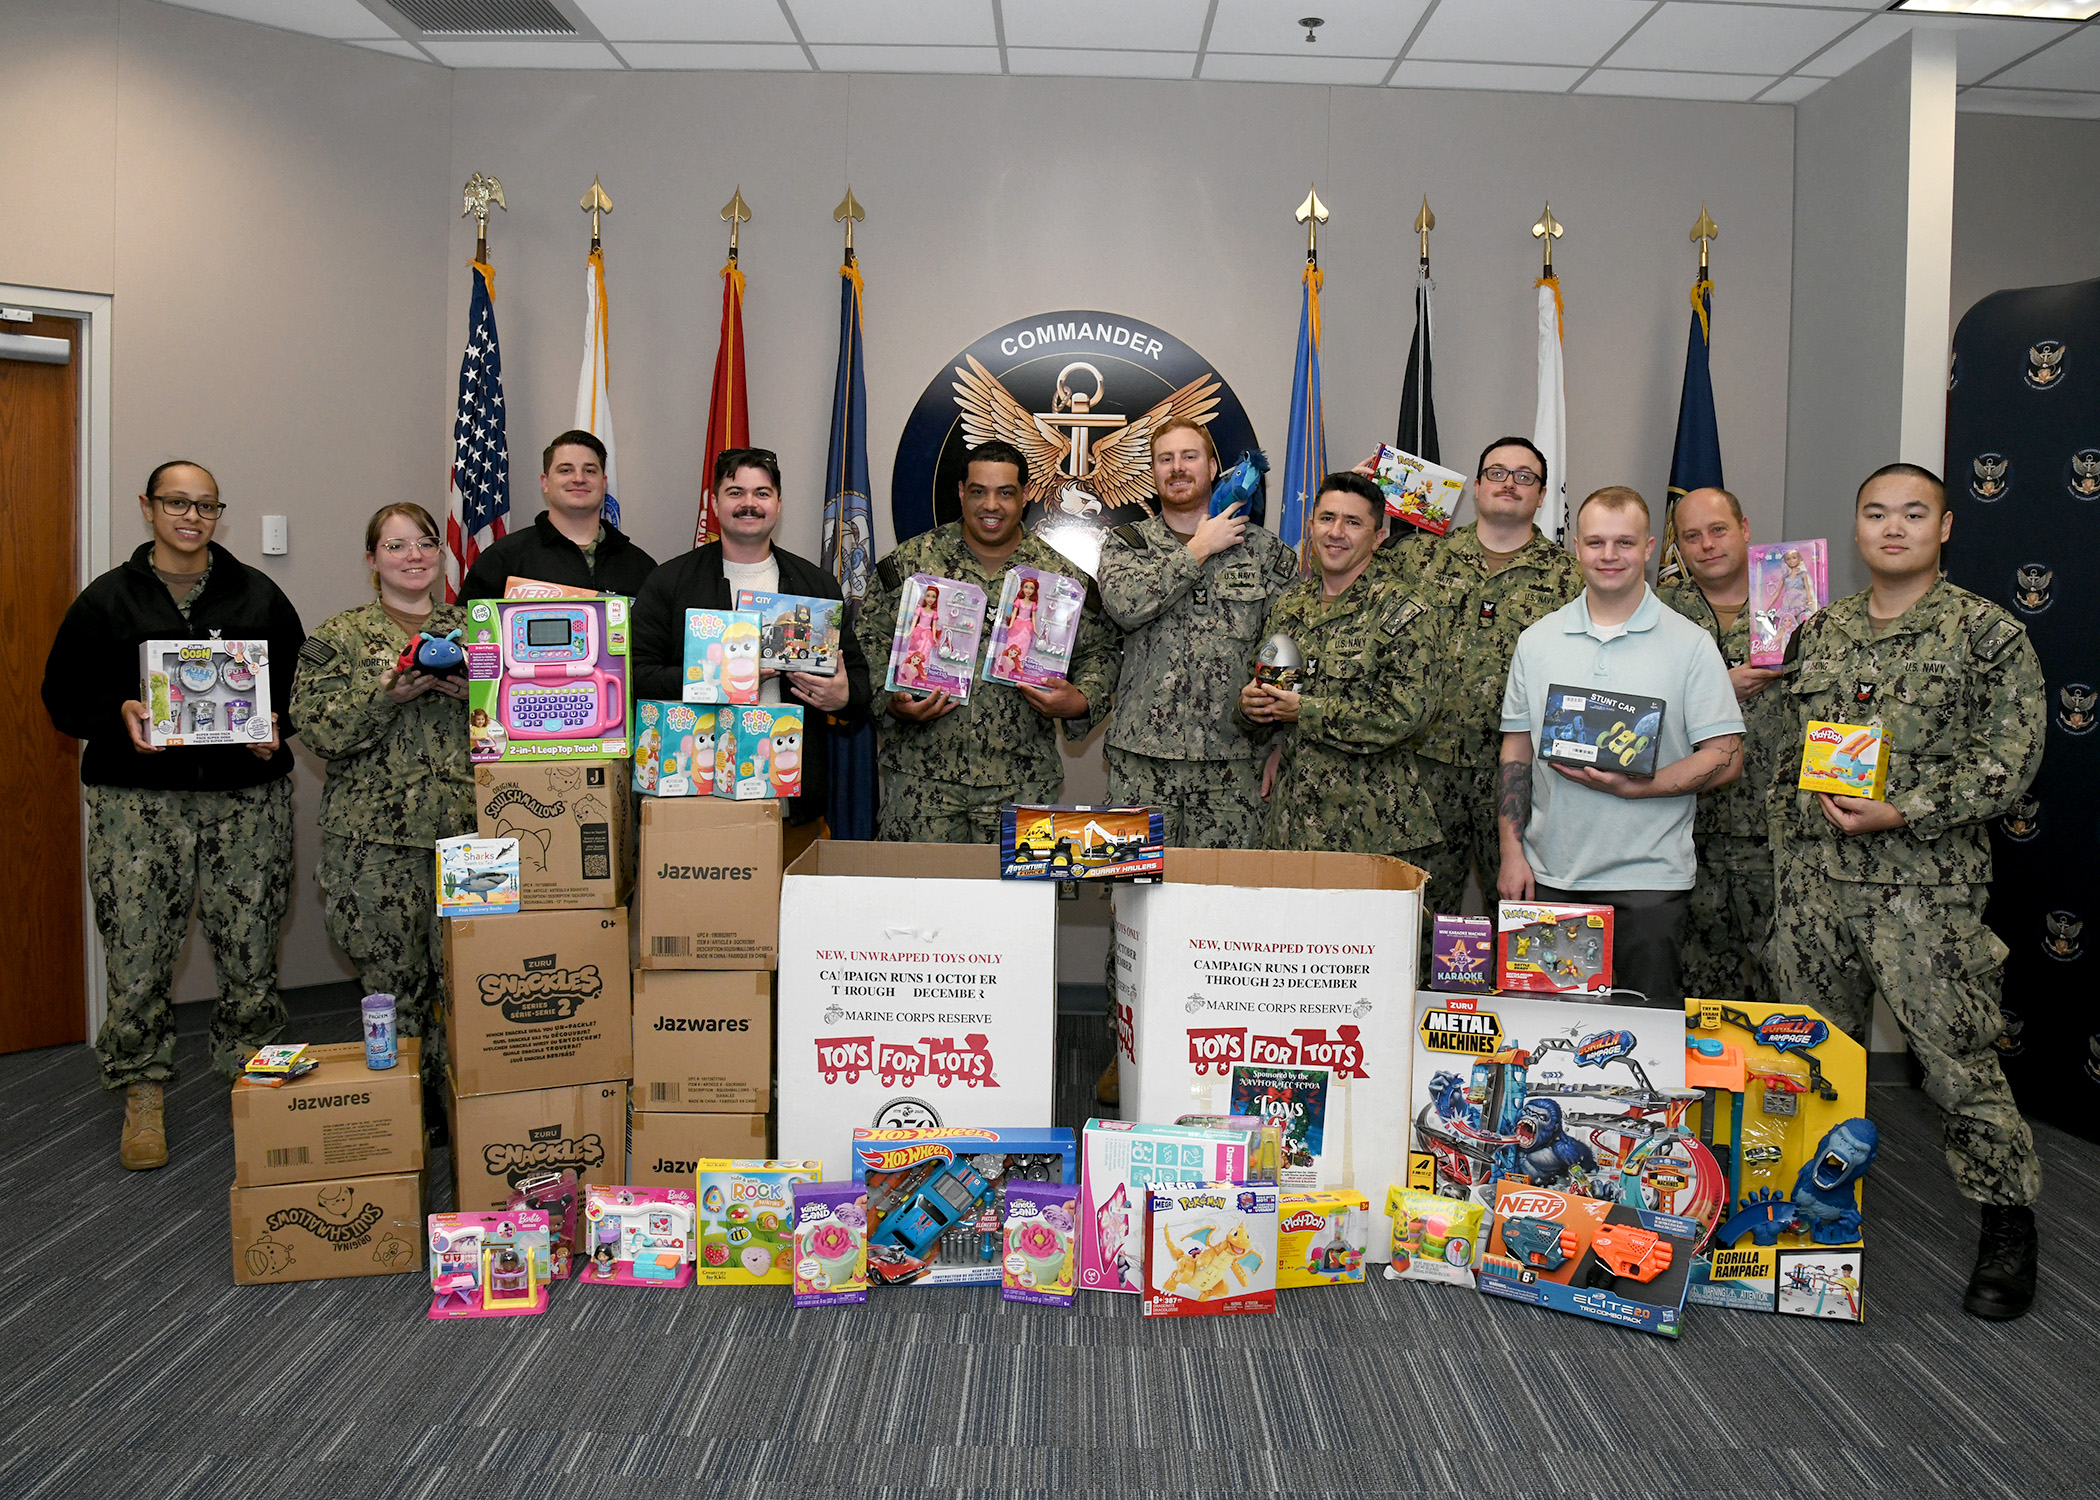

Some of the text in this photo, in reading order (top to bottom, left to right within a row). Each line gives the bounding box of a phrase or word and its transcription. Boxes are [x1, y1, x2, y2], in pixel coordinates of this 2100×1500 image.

[1000, 322, 1164, 361] COMMANDER
[1239, 571, 1256, 580] NAVY
[755, 595, 772, 605] CITY
[690, 614, 723, 628] Potato
[690, 623, 725, 639] Head
[1750, 640, 1779, 654] Barbie
[1905, 663, 1946, 674] U.S. NAVY
[1591, 693, 1636, 714] STUNT CAR
[668, 706, 696, 719] Potato
[743, 709, 773, 722] Potato
[667, 714, 697, 732] Head
[743, 718, 775, 735] Head
[510, 742, 598, 756] 2-in-1 LeapTop Touch
[492, 782, 520, 794] ORIGINAL
[485, 789, 565, 819] SQUISHMALLOWS
[464, 851, 495, 861] Sharks
[658, 863, 752, 880] Jazwares
[1006, 862, 1048, 874] ADVENTURE
[1090, 867, 1120, 876] QUARRY
[1122, 862, 1157, 873] HAULERS
[601, 920, 616, 929] 0+
[1189, 939, 1376, 955] NEW, UNWRAPPED TOYS ONLY
[816, 949, 1003, 964] NEW, UNWRAPPED TOYS ONLY
[528, 960, 552, 968] ZURU
[1193, 959, 1370, 975] CAMPAIGN RUNS 1 OCTOBER
[890, 972, 924, 984] RUNS
[927, 974, 932, 984] 1
[1205, 975, 1358, 989] THROUGH 23 DECEMBER
[1437, 972, 1484, 980] KARAOKE
[478, 965, 603, 1006] SNACKLES
[522, 1002, 548, 1010] SERIES
[557, 998, 571, 1016] 2
[1206, 1001, 1352, 1014] MARINE CORPS RESERVE
[1450, 1002, 1474, 1011] ZURU
[653, 1016, 749, 1032] Jazwares
[845, 1010, 992, 1024] MARINE CORPS RESERVE
[1429, 1012, 1494, 1035] METAL
[1761, 1021, 1815, 1034] GORILLA
[1428, 1031, 1495, 1054] MACHINES
[1768, 1034, 1812, 1044] RAMPAGE
[1191, 1033, 1357, 1067] TOYS FOR TOTS
[1586, 1045, 1622, 1060] RAMPAGE
[820, 1042, 986, 1076] TOYS FOR TOTS
[1253, 1070, 1287, 1081] Sponsored
[1288, 1072, 1296, 1081] by
[602, 1089, 616, 1098] 0+
[288, 1091, 371, 1111] Jazwares
[1254, 1095, 1304, 1121] Toys
[534, 1130, 557, 1139] ZURU
[484, 1133, 605, 1176] SNACKLES
[1656, 1180, 1680, 1188] MACHINES
[1657, 1173, 1679, 1182] METAL
[731, 1182, 783, 1201] ROCK
[1148, 1182, 1197, 1191] MEGA
[667, 1190, 690, 1200] Barbie
[801, 1203, 828, 1213] Kinetic
[1009, 1201, 1036, 1210] Kinetic
[1155, 1200, 1172, 1209] MEGA
[1497, 1196, 1564, 1213] NERF
[518, 1213, 542, 1224] Barbie
[800, 1210, 831, 1222] SAND
[1009, 1207, 1039, 1218] SAND
[266, 1203, 384, 1242] SQUISHMALLOWS
[1281, 1212, 1326, 1231] Play-Doh
[1717, 1252, 1759, 1264] GORILLA
[1715, 1265, 1769, 1278] RAMPAGE!
[1573, 1293, 1651, 1319] ELITE 2.0
[1579, 1305, 1642, 1325] TRIO COMBO PACK
